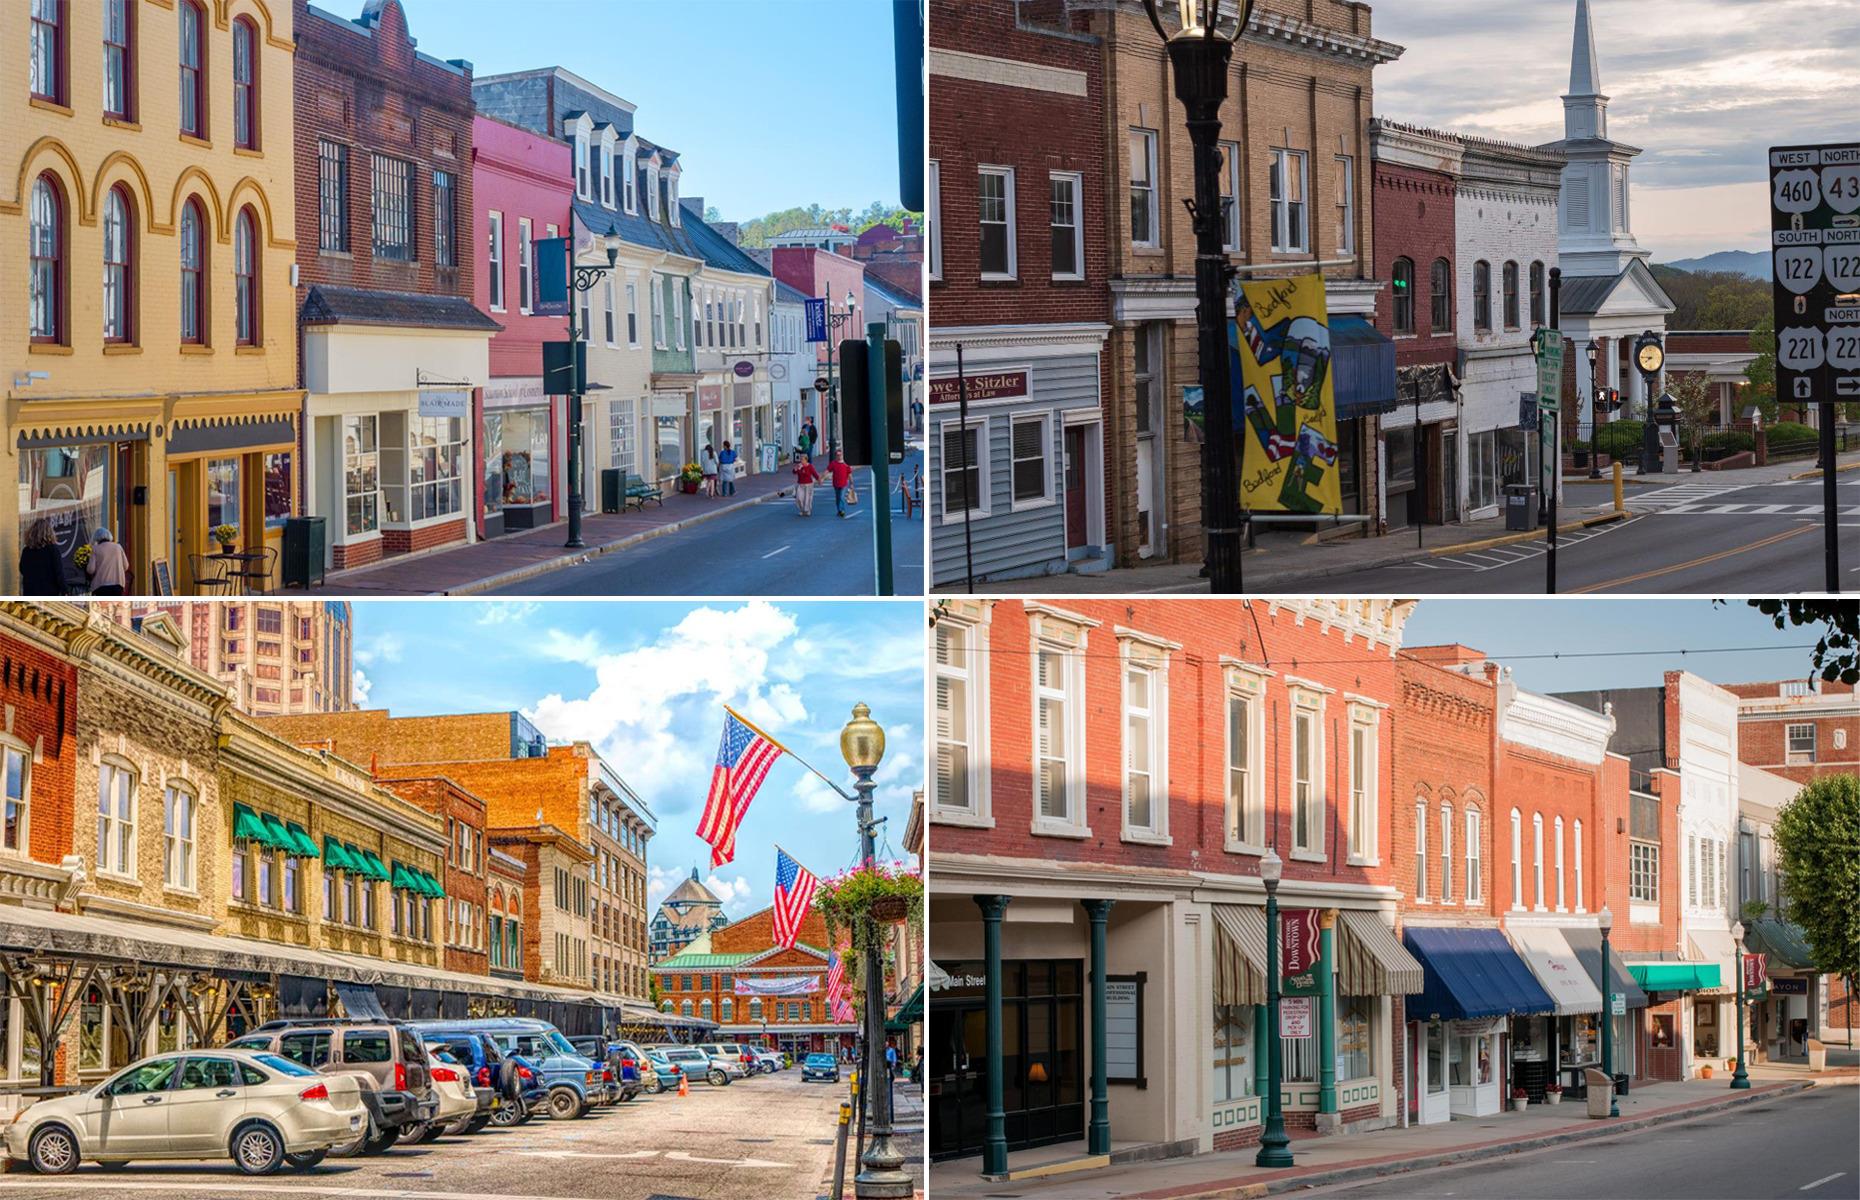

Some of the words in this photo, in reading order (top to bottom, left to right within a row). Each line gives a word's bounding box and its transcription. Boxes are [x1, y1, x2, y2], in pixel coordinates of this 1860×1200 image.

[1779, 153, 1810, 164] WEST
[1780, 180, 1812, 202] 460
[1829, 176, 1859, 198] 43
[1778, 231, 1817, 243] SOUTH
[1827, 230, 1860, 241] NORT
[1784, 257, 1814, 279] 122
[1831, 256, 1860, 277] 122
[1254, 279, 1298, 319] Bedford
[1788, 337, 1815, 359] 221
[975, 376, 1019, 390] Sitzler
[982, 389, 996, 398] Law
[1288, 919, 1300, 969] DOWNTOWN
[1774, 983, 1799, 991] AVON
